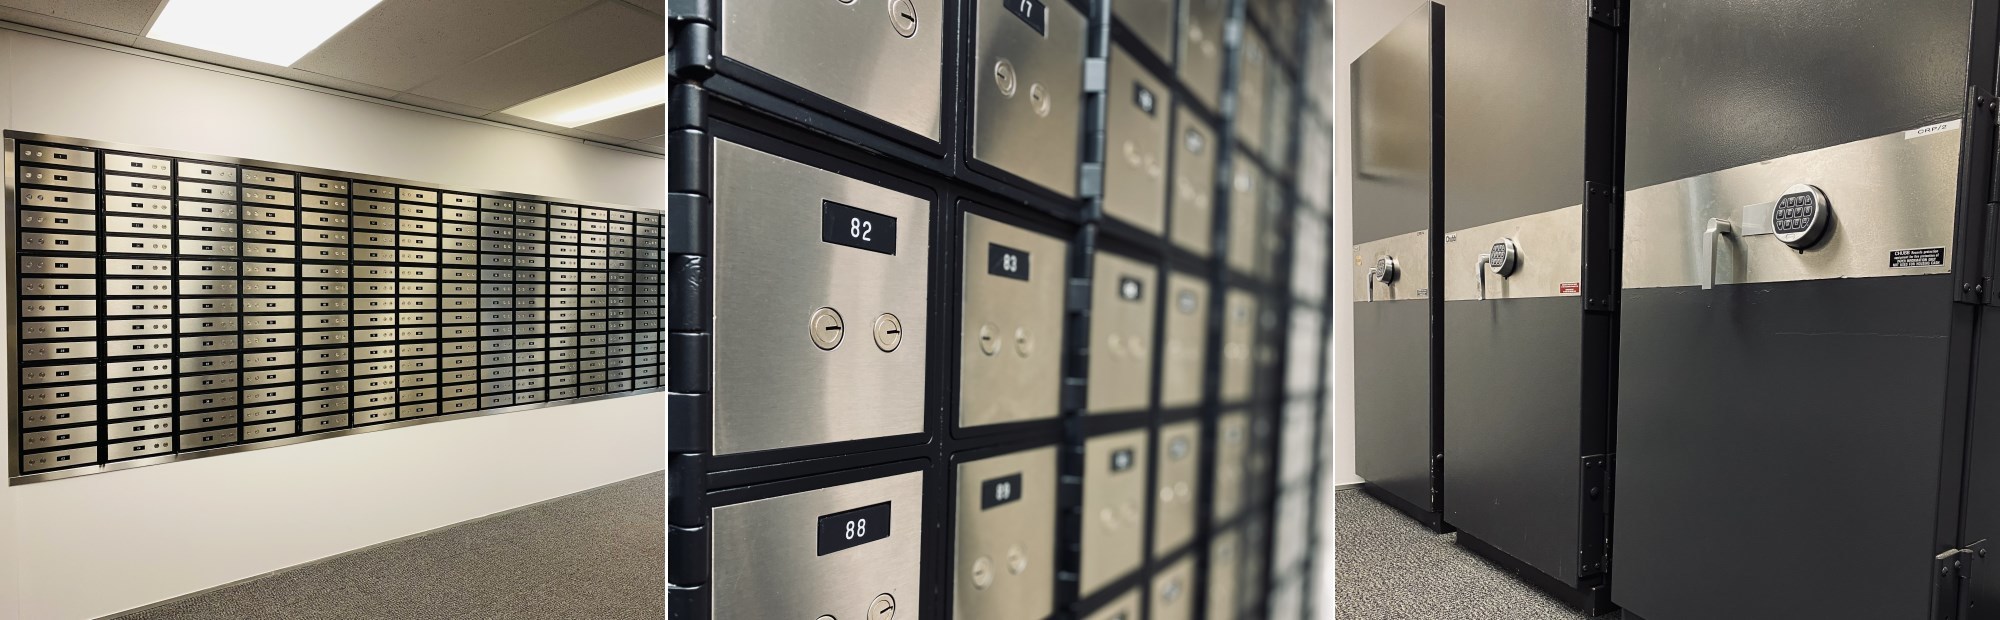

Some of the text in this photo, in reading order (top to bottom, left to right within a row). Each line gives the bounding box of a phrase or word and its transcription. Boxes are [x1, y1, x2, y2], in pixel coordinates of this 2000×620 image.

[850, 217, 872, 242] 82
[1002, 253, 1018, 272] 83
[995, 482, 1011, 500] 89
[845, 518, 866, 540] 88
